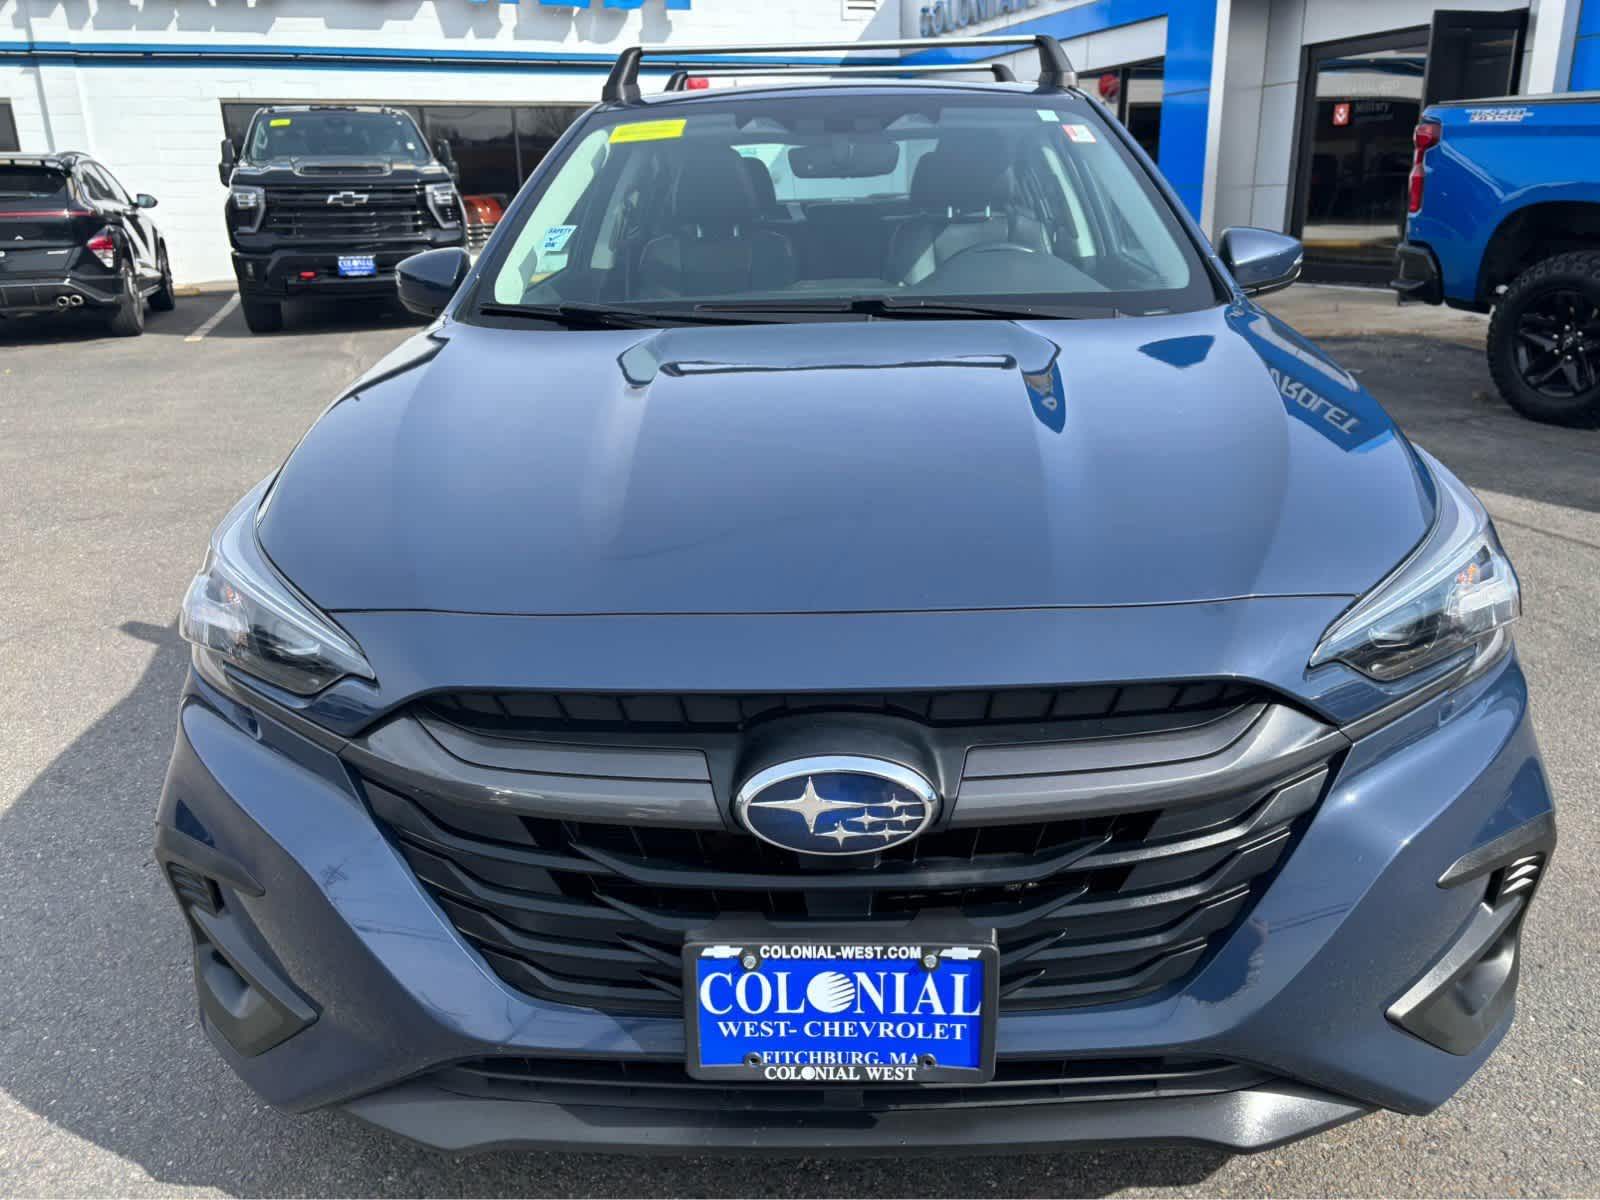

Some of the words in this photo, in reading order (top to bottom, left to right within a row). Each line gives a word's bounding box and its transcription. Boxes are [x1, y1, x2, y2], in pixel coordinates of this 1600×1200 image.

[760, 945, 921, 960] COLONIAL-WEST.COM
[700, 971, 981, 1016] COLONIAL
[804, 1022, 967, 1040] CHEVROLET
[890, 1052, 918, 1065] MA
[764, 1066, 860, 1080] COLONIAL
[865, 1066, 917, 1080] WEST
